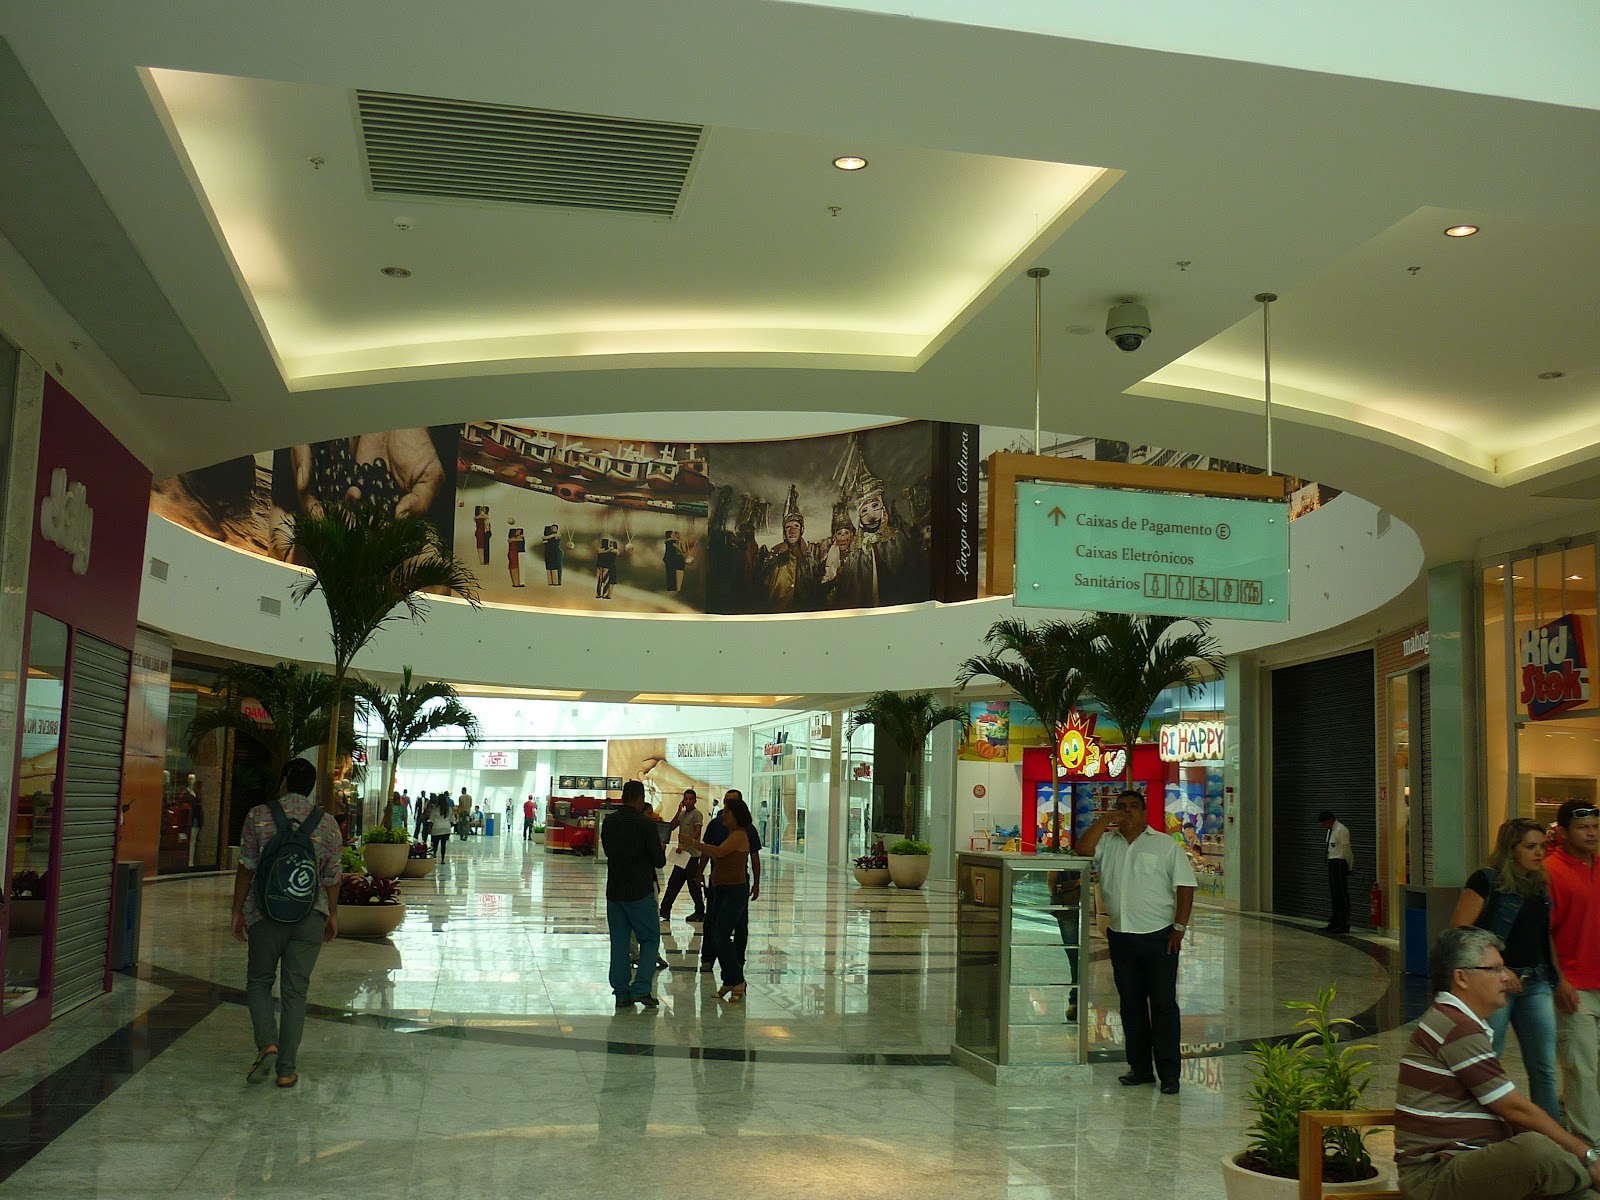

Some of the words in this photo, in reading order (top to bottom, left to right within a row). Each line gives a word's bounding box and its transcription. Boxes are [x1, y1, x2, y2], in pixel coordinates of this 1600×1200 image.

[956, 428, 969, 494] Cultura
[956, 500, 969, 523] da
[1076, 513, 1118, 529] Caixas
[1121, 517, 1137, 530] de
[1141, 518, 1212, 536] Pagamento
[956, 524, 972, 582] Largo
[1075, 544, 1118, 560] Caixas
[1122, 547, 1194, 565] Eletrônicos
[1074, 573, 1140, 590] Sanitários
[1521, 625, 1568, 667] Kid
[1520, 659, 1588, 704] Stok
[1161, 730, 1176, 756] RI
[1178, 727, 1224, 756] HAPPY
